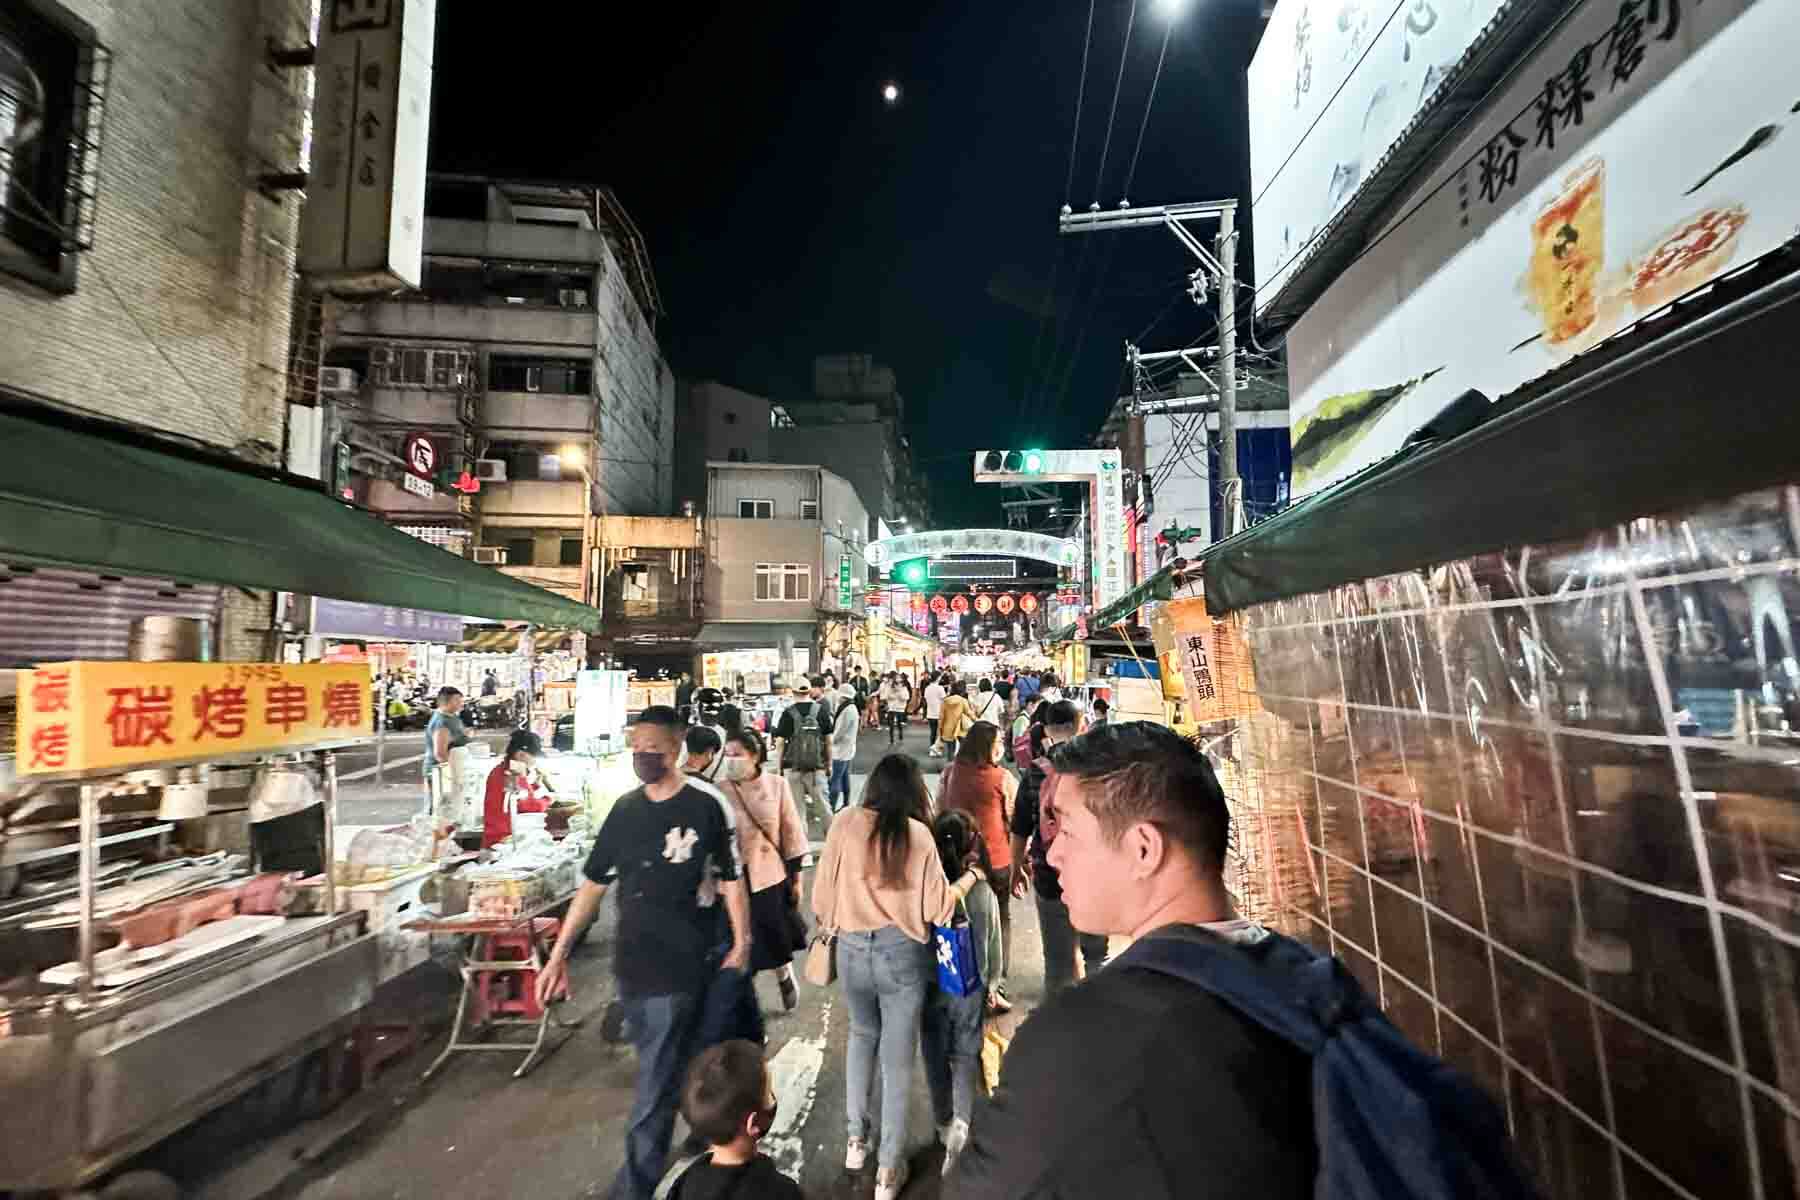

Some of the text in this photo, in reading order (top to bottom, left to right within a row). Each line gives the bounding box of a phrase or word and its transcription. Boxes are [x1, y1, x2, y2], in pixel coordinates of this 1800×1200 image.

[1187, 635, 1216, 700] 東山鴨頭
[105, 683, 362, 748] 碳烤串燒
